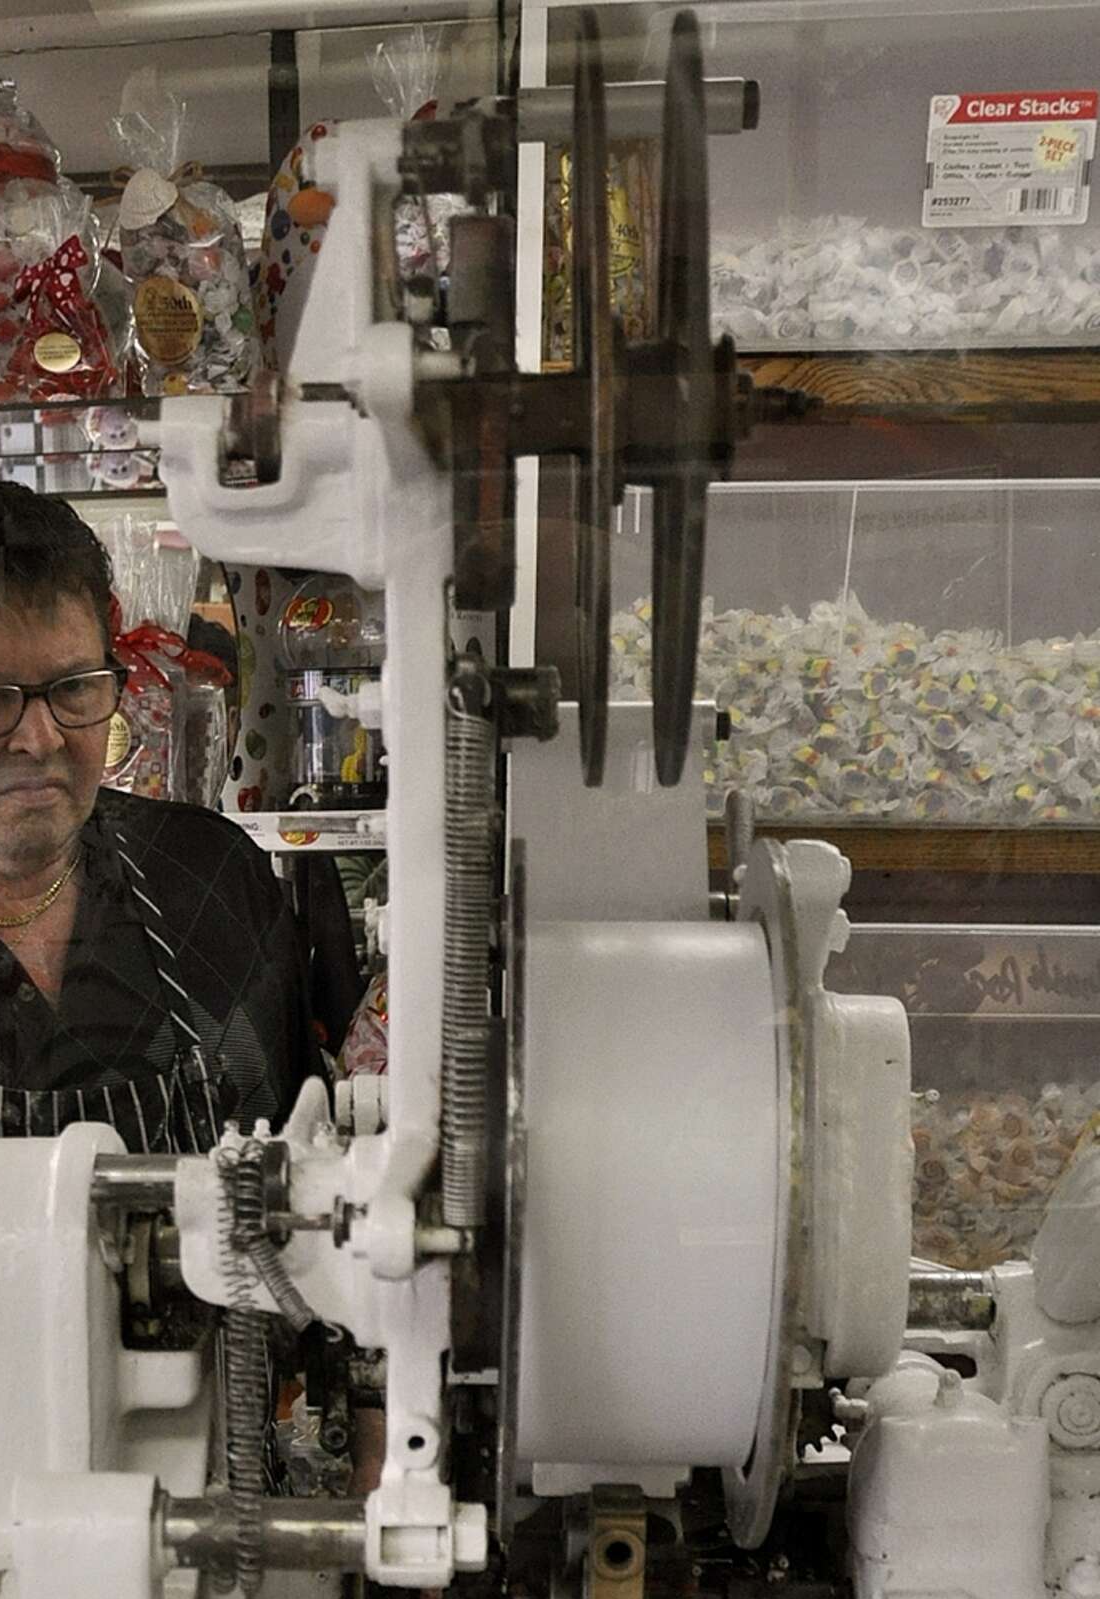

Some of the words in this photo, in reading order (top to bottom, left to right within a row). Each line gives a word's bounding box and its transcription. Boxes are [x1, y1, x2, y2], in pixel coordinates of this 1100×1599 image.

[966, 100, 1014, 118] Clear
[1038, 135, 1076, 152] 2-PIECE
[1044, 150, 1066, 162] SET
